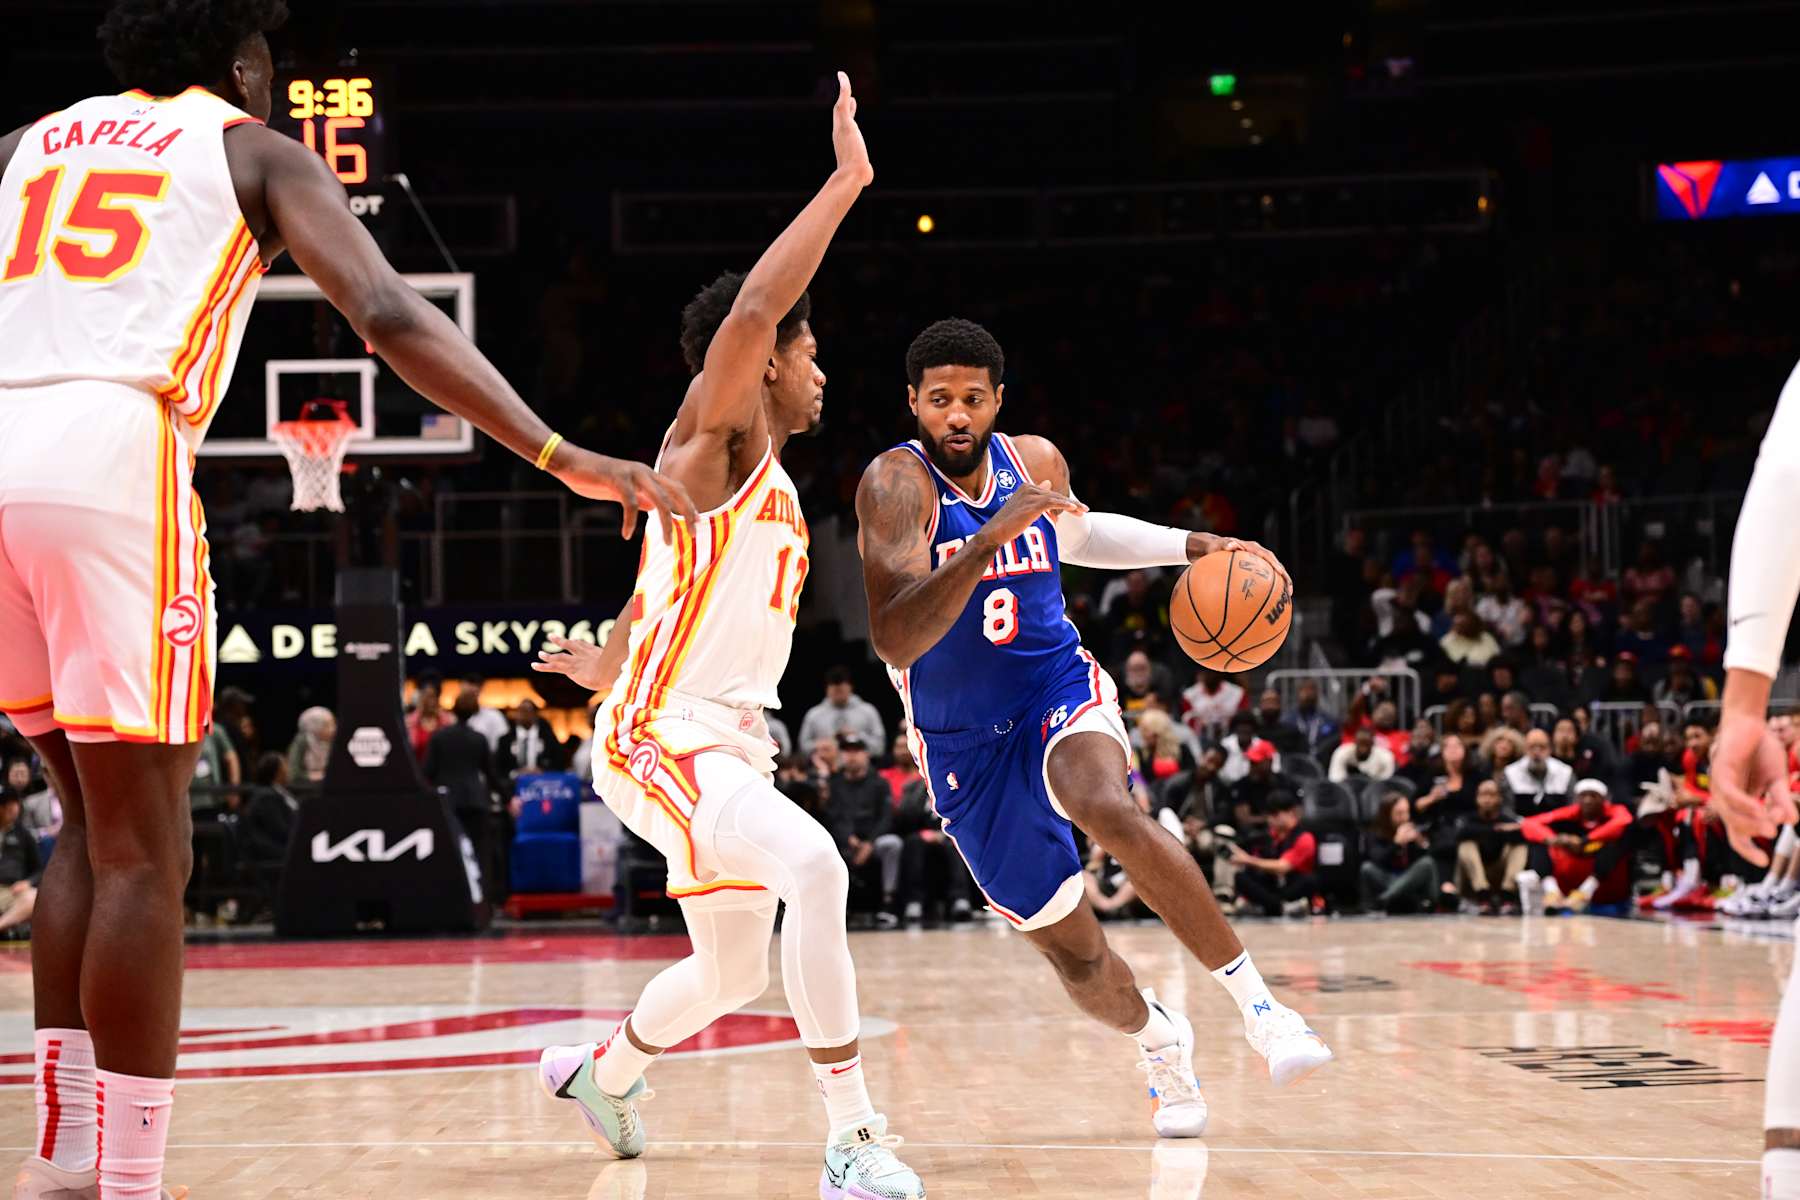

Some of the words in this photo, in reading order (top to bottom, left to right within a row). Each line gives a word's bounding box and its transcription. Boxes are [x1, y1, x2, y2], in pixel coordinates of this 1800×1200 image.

[288, 78, 374, 119] 9:36
[43, 120, 184, 157] CAPELA
[1, 164, 172, 284] 15
[983, 587, 1019, 646] 8
[271, 621, 439, 659] DEA
[311, 828, 434, 862] KIA
